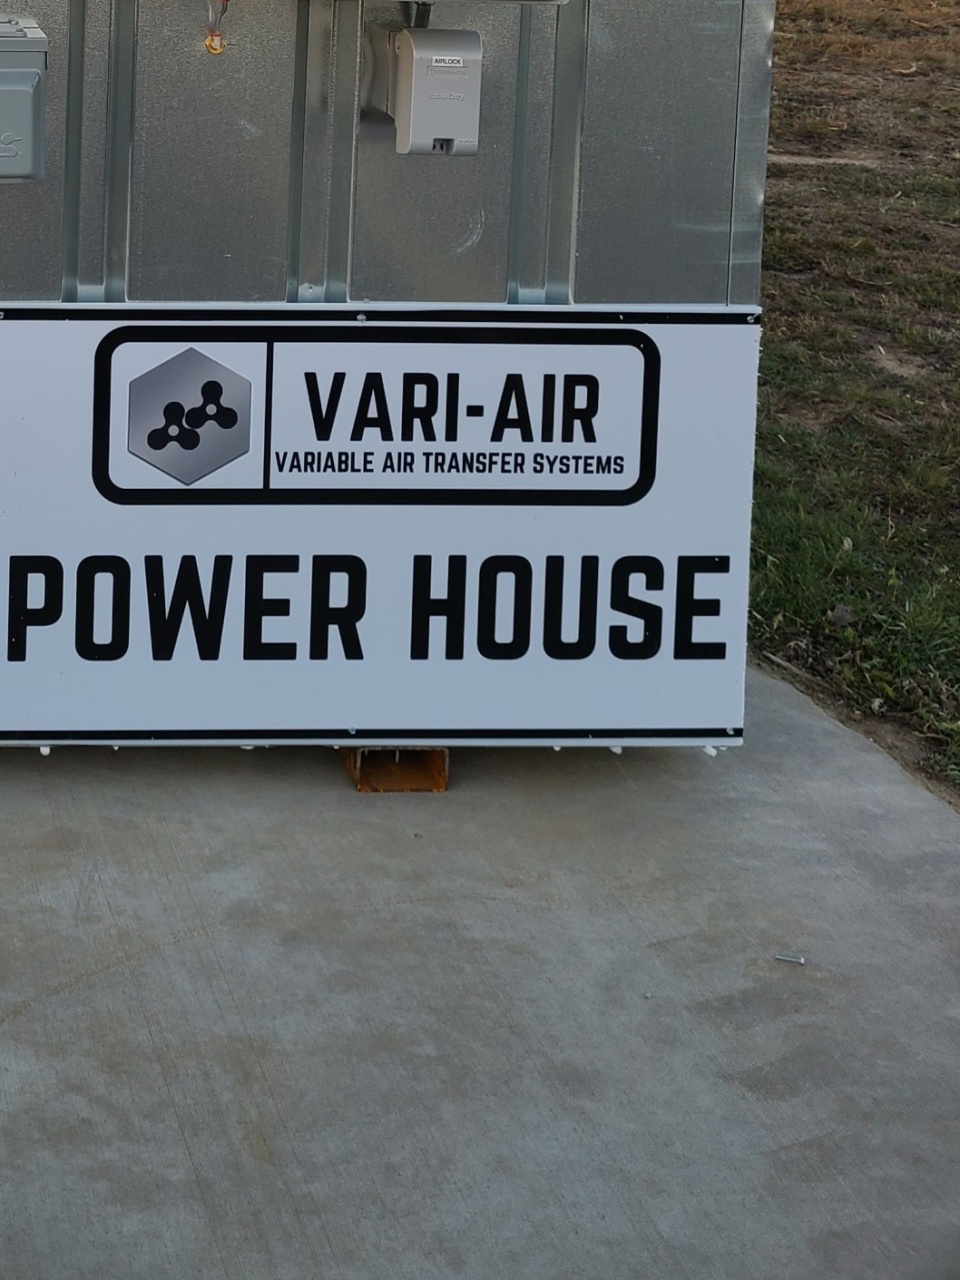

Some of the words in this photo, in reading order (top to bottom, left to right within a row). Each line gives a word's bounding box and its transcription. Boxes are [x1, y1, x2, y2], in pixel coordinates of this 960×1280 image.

[303, 371, 600, 444] VARI-AIR
[275, 451, 374, 475] VARIABLE
[382, 452, 416, 475] AIR
[422, 452, 528, 475] TRANSFER
[533, 453, 625, 476] SYSTEMS
[6, 554, 368, 662] POWER
[410, 554, 731, 661] HOUSE
